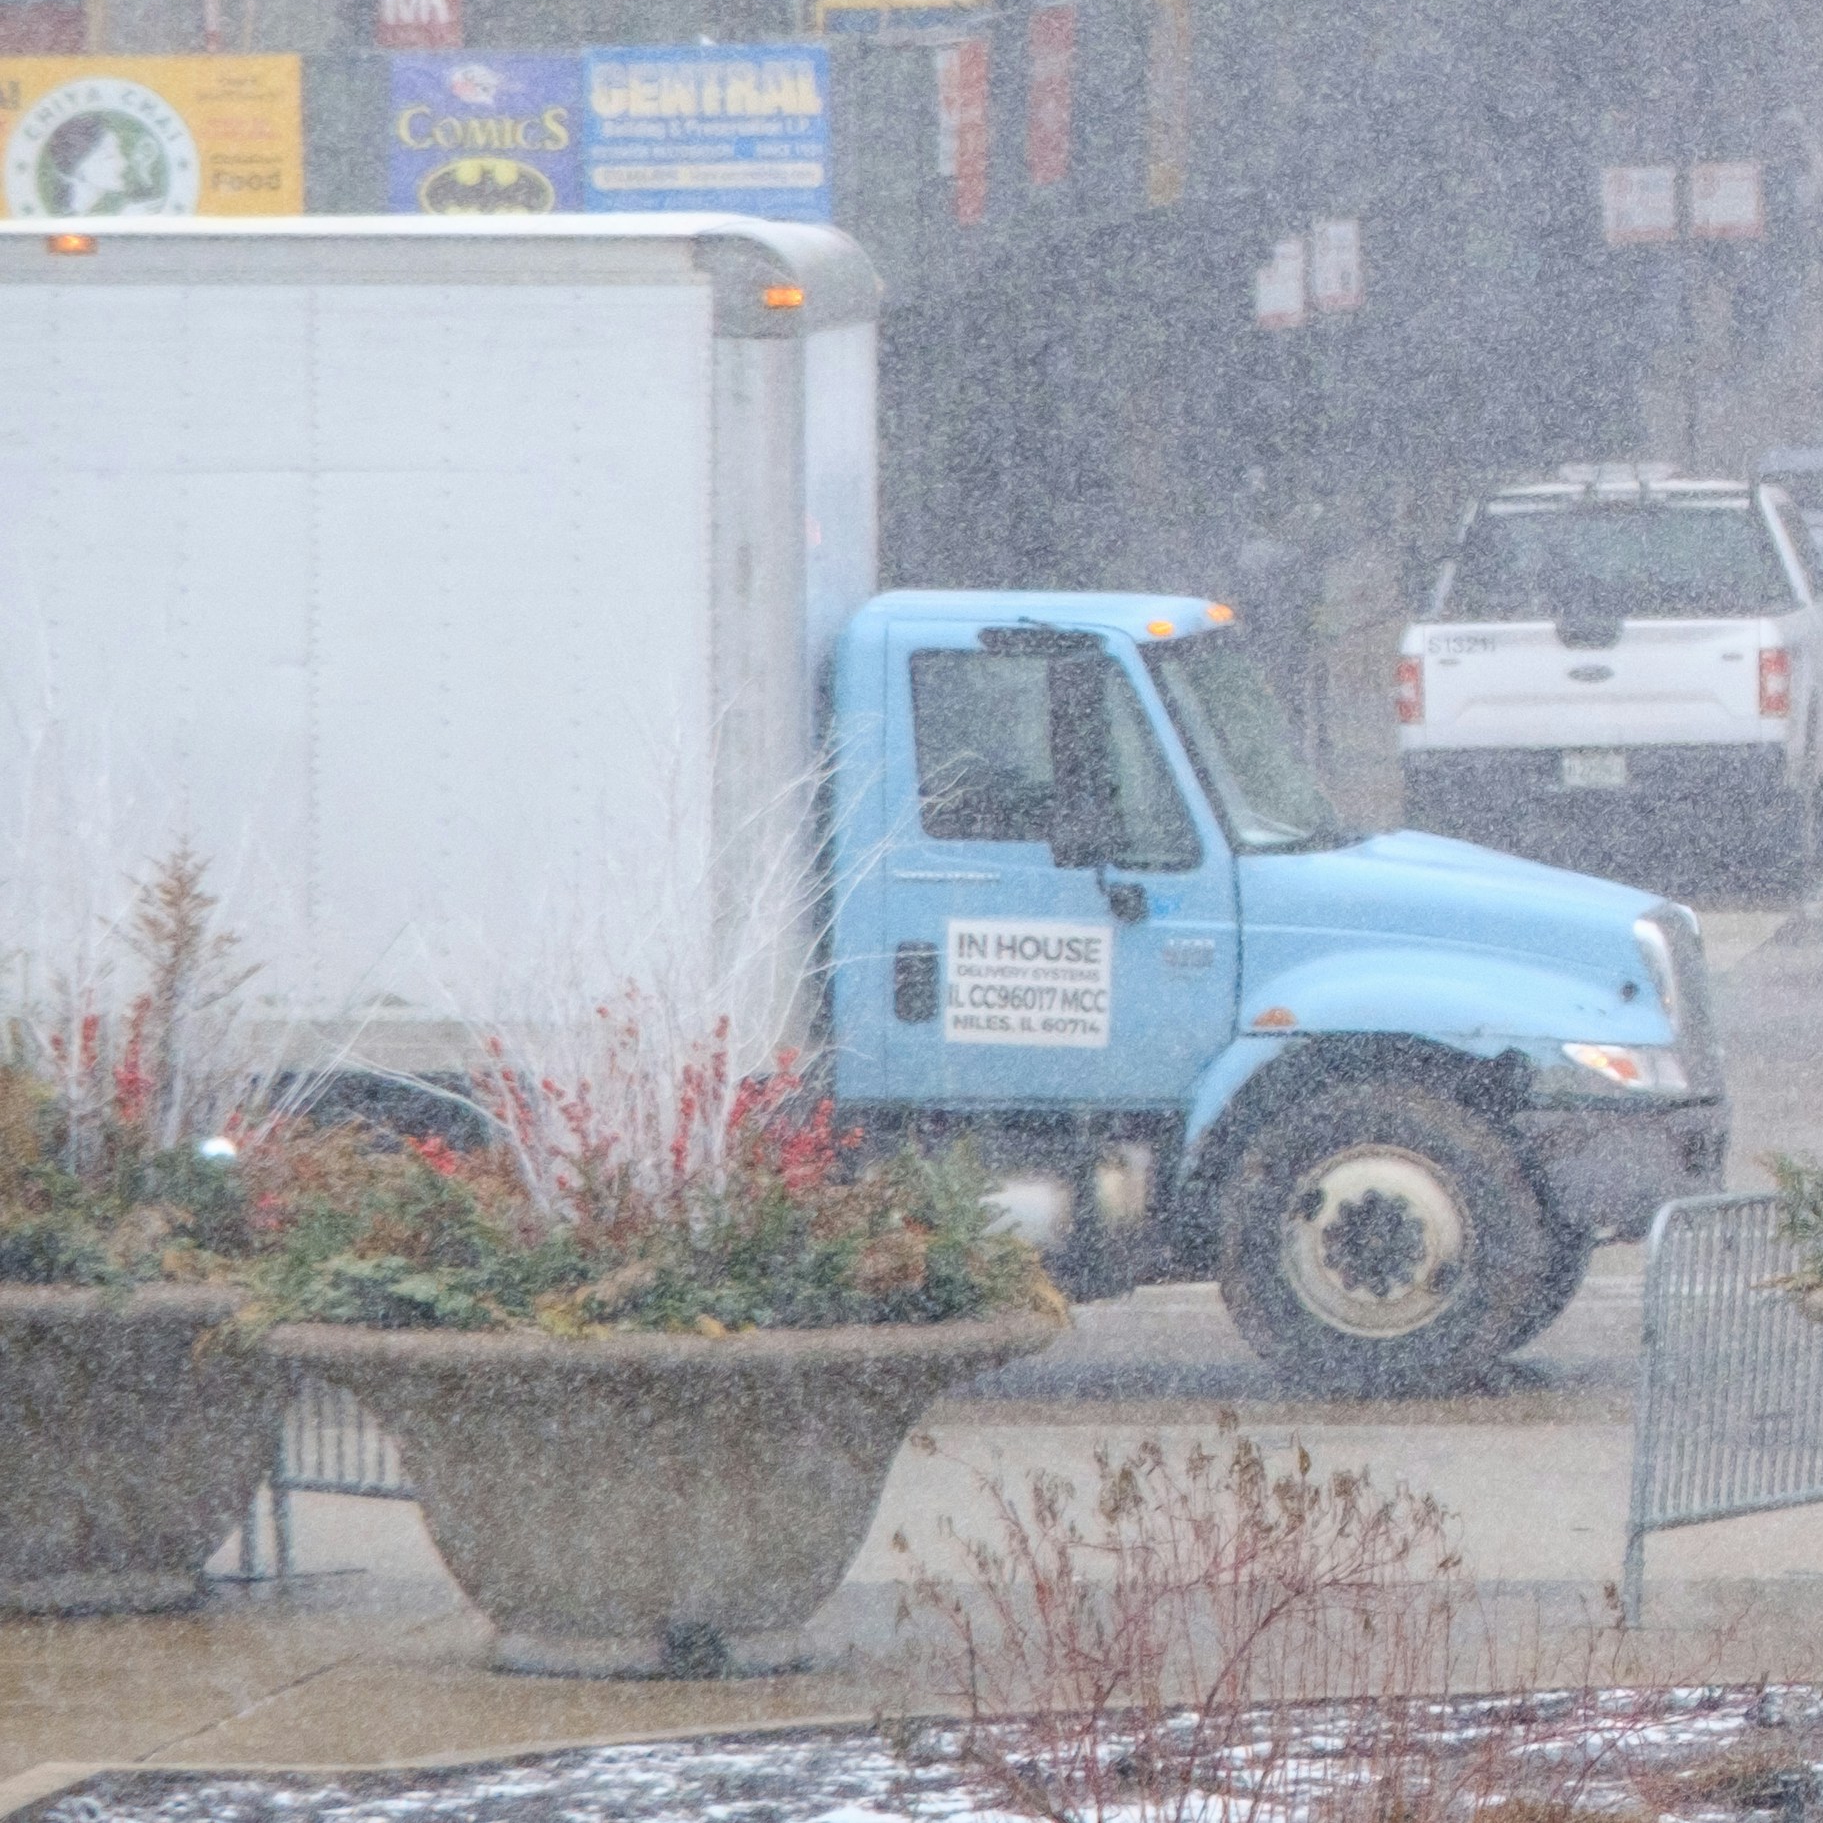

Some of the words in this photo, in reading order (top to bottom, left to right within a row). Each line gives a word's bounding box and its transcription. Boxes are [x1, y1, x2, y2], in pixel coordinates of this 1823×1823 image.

[590, 60, 822, 116] CENTRAL
[958, 934, 987, 959] IN
[995, 934, 1101, 964] HOUSE
[957, 964, 1027, 979] DELIVERY
[1032, 966, 1100, 982] SYSTEMS
[948, 984, 964, 1008] IL
[1061, 989, 1107, 1013] MCC
[1020, 1017, 1036, 1032] IL
